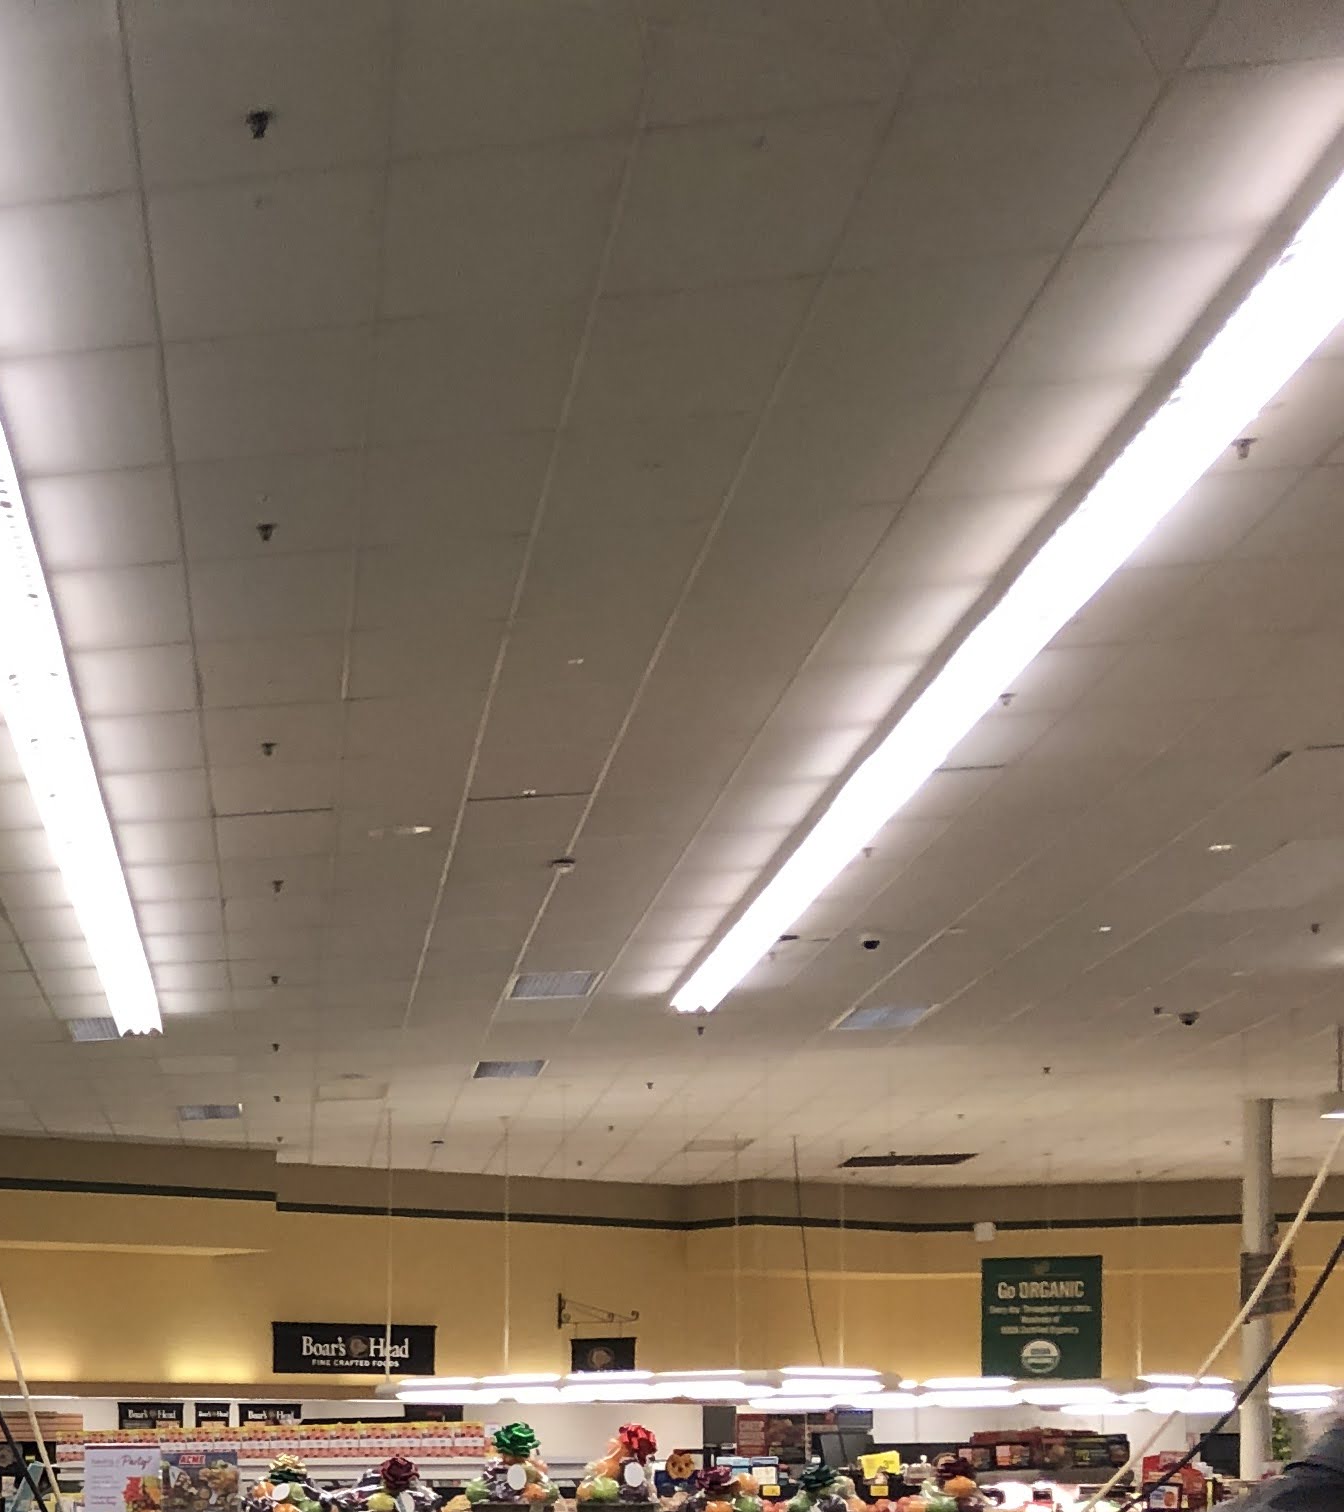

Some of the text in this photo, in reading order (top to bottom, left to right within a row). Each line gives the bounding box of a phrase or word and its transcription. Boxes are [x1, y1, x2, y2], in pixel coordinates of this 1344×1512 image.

[998, 1280, 1085, 1299] Go ORGANIC
[302, 1336, 409, 1358] Boar's Had
[334, 1359, 369, 1367] CRAFTED
[179, 1455, 206, 1465] ACME
